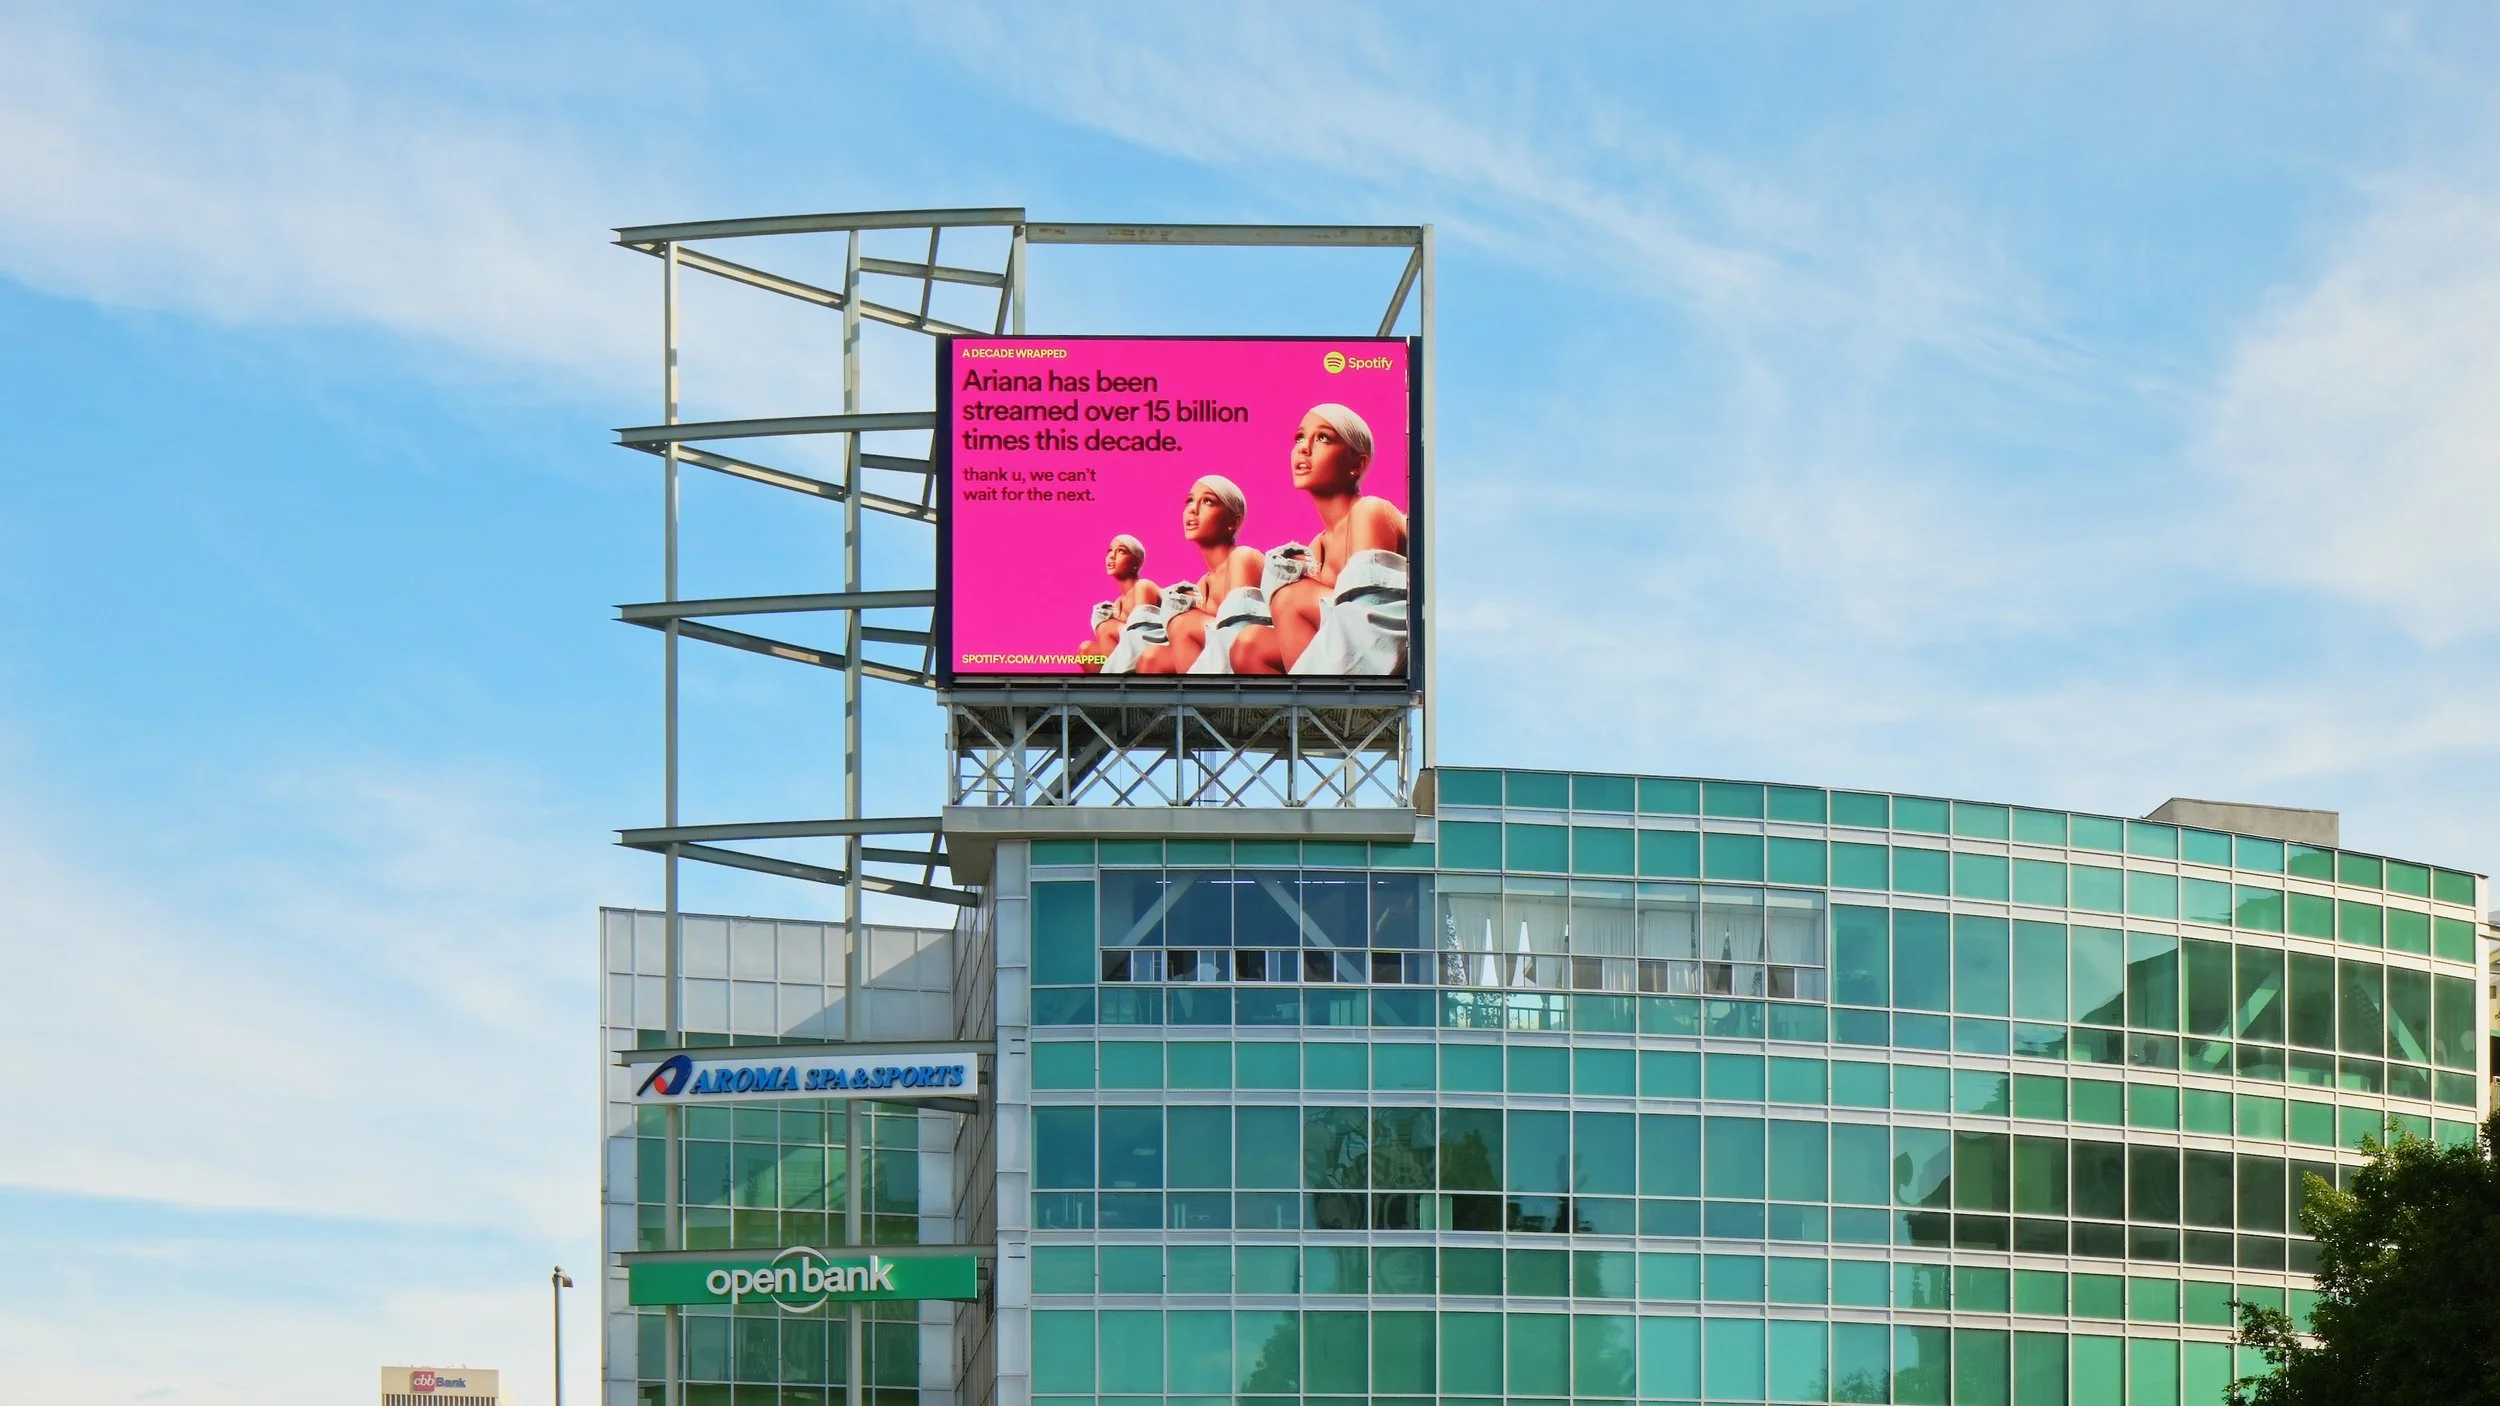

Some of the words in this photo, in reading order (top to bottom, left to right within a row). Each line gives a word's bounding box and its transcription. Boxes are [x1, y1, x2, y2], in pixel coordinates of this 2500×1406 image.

[962, 349, 971, 358] A
[971, 349, 1014, 358] DECADE
[1015, 349, 1067, 359] WRAPPED
[1348, 356, 1393, 371] Spotify
[962, 369, 1042, 392] Ariana
[1049, 369, 1090, 392] has
[1096, 369, 1158, 392] been
[962, 400, 1079, 422] streamed
[1084, 404, 1139, 422] over
[1144, 400, 1171, 422] 15
[1177, 400, 1249, 423] billion
[962, 428, 1030, 451] times
[1035, 428, 1079, 451] this
[1084, 429, 1183, 452] decade.
[962, 467, 1008, 482] thank
[1012, 471, 1026, 484] u,
[1029, 471, 1054, 482] we
[1057, 468, 1096, 482] can’t
[963, 487, 997, 501] wait
[1001, 487, 1025, 501] for
[1027, 487, 1053, 501] the
[1057, 488, 1095, 501] next.
[961, 654, 1107, 665] SPOTIFY.COM/MYWRAPPED
[690, 1066, 798, 1094] AROMA
[804, 1065, 964, 1090] SPA&SPORTS
